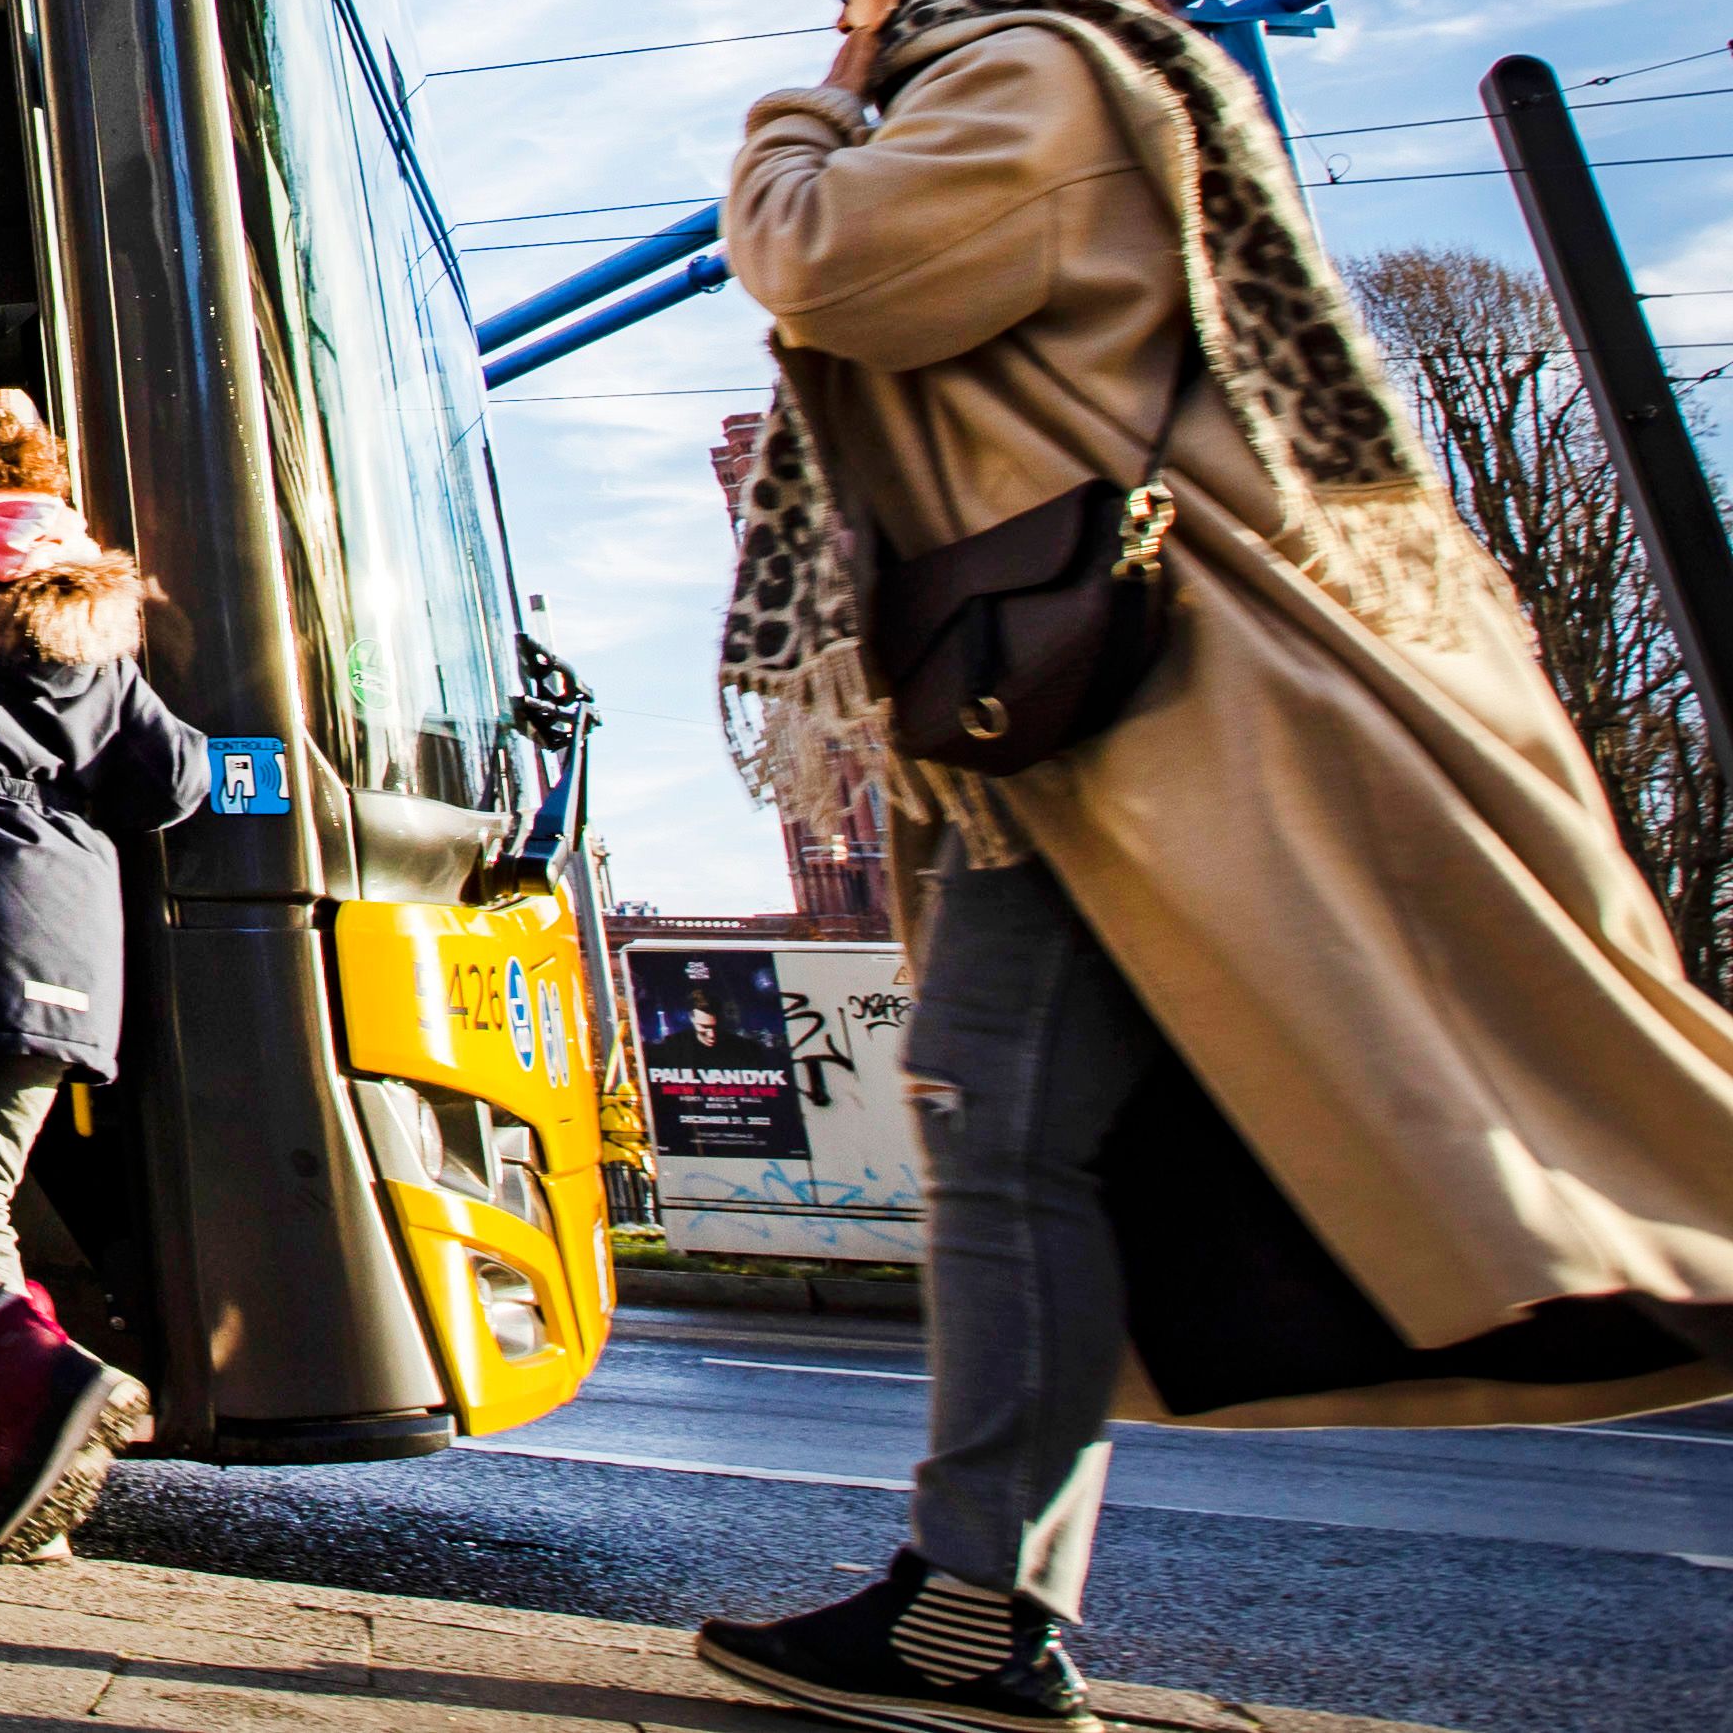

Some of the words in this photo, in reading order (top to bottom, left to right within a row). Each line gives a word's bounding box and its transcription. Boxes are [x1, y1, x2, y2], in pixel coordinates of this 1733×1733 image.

[649, 1068, 700, 1084] PAUL
[700, 1069, 742, 1085] VAN
[745, 1070, 787, 1086] DYK
